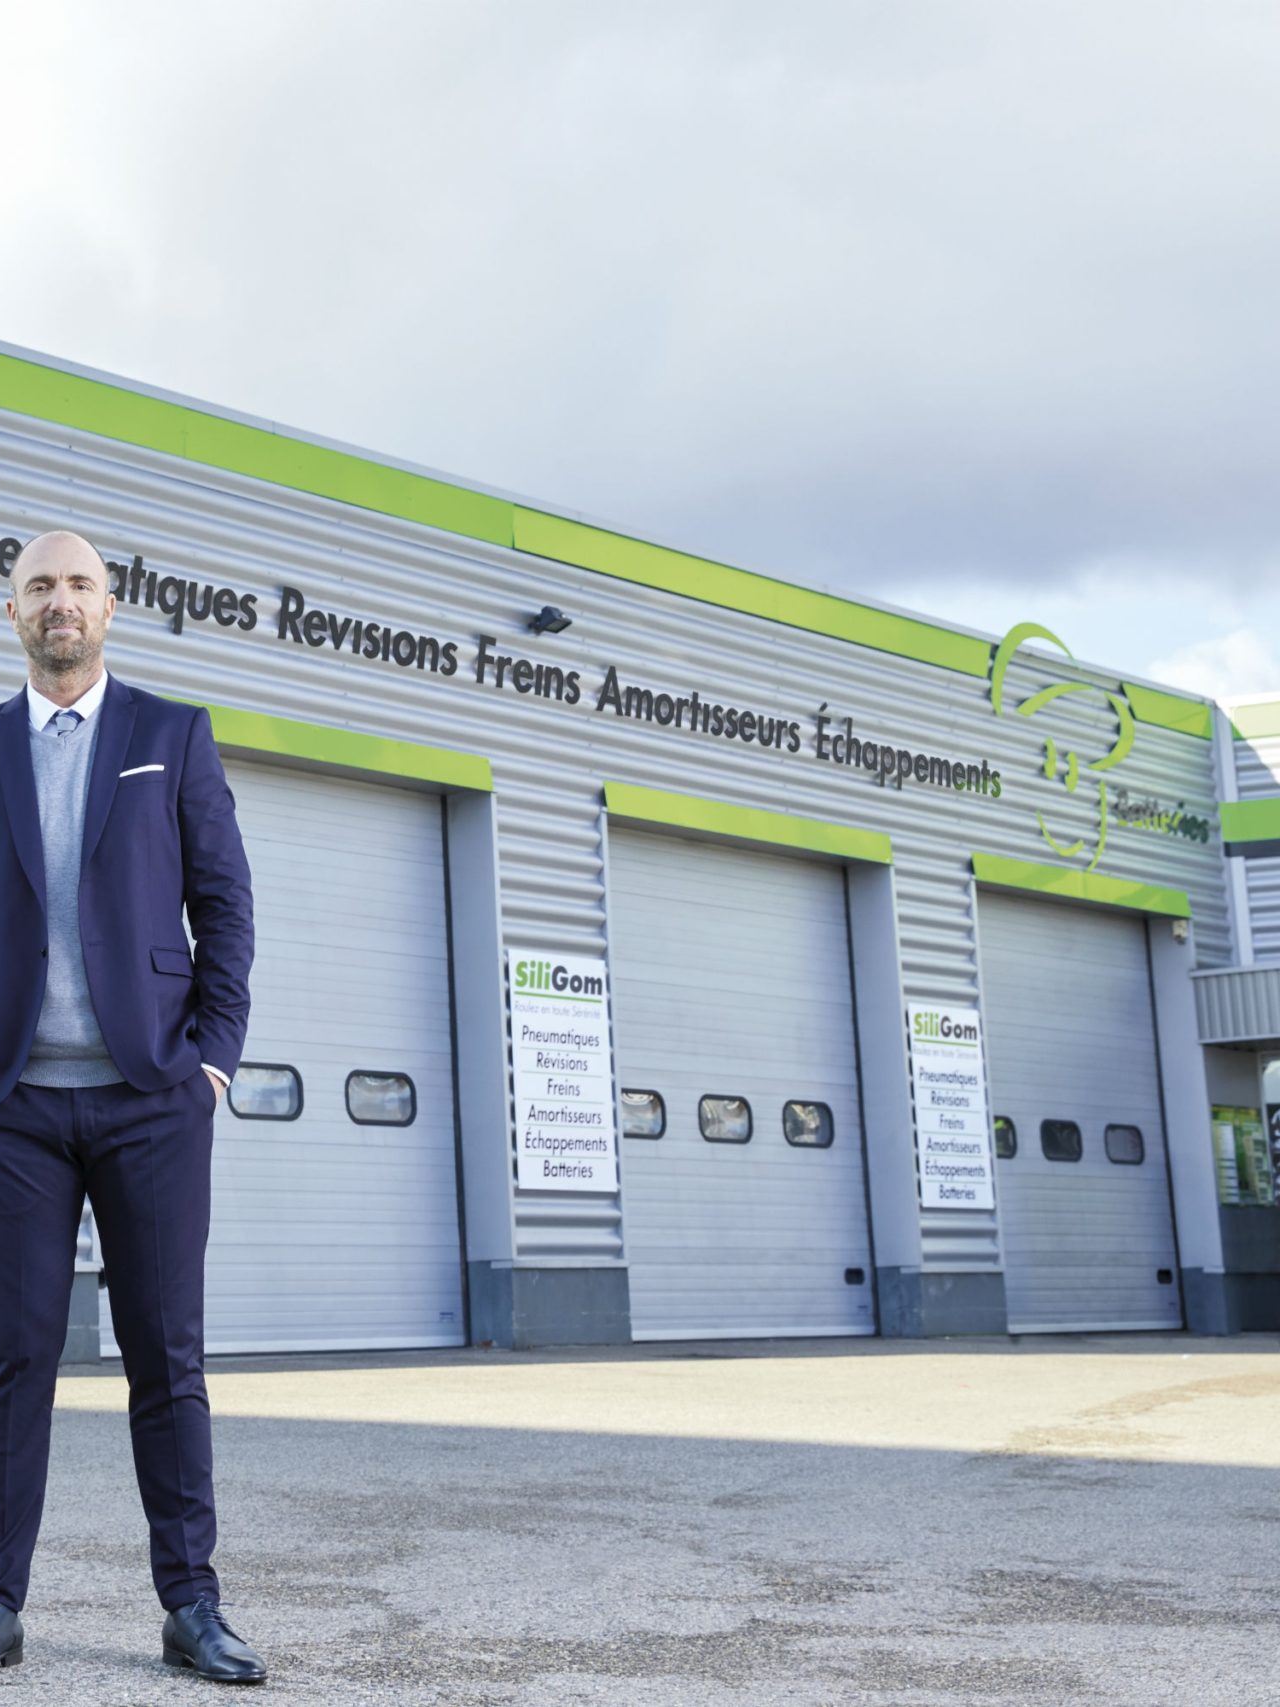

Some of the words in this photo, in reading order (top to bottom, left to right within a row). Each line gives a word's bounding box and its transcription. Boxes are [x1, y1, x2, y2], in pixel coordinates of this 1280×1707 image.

[277, 586, 458, 676] Revisions
[476, 633, 581, 705] Freins
[596, 665, 801, 753] Amortisseurs
[816, 701, 1002, 798] Échappements
[514, 960, 603, 996] SiliGom
[521, 1024, 600, 1050] Pneumatiques
[913, 1011, 978, 1040] SiliGom
[546, 1078, 581, 1097] Freins
[527, 1103, 603, 1125] Amortisseurs
[939, 1113, 965, 1130] Freins
[524, 1127, 608, 1156] Échappements
[543, 1159, 593, 1178] Batteries
